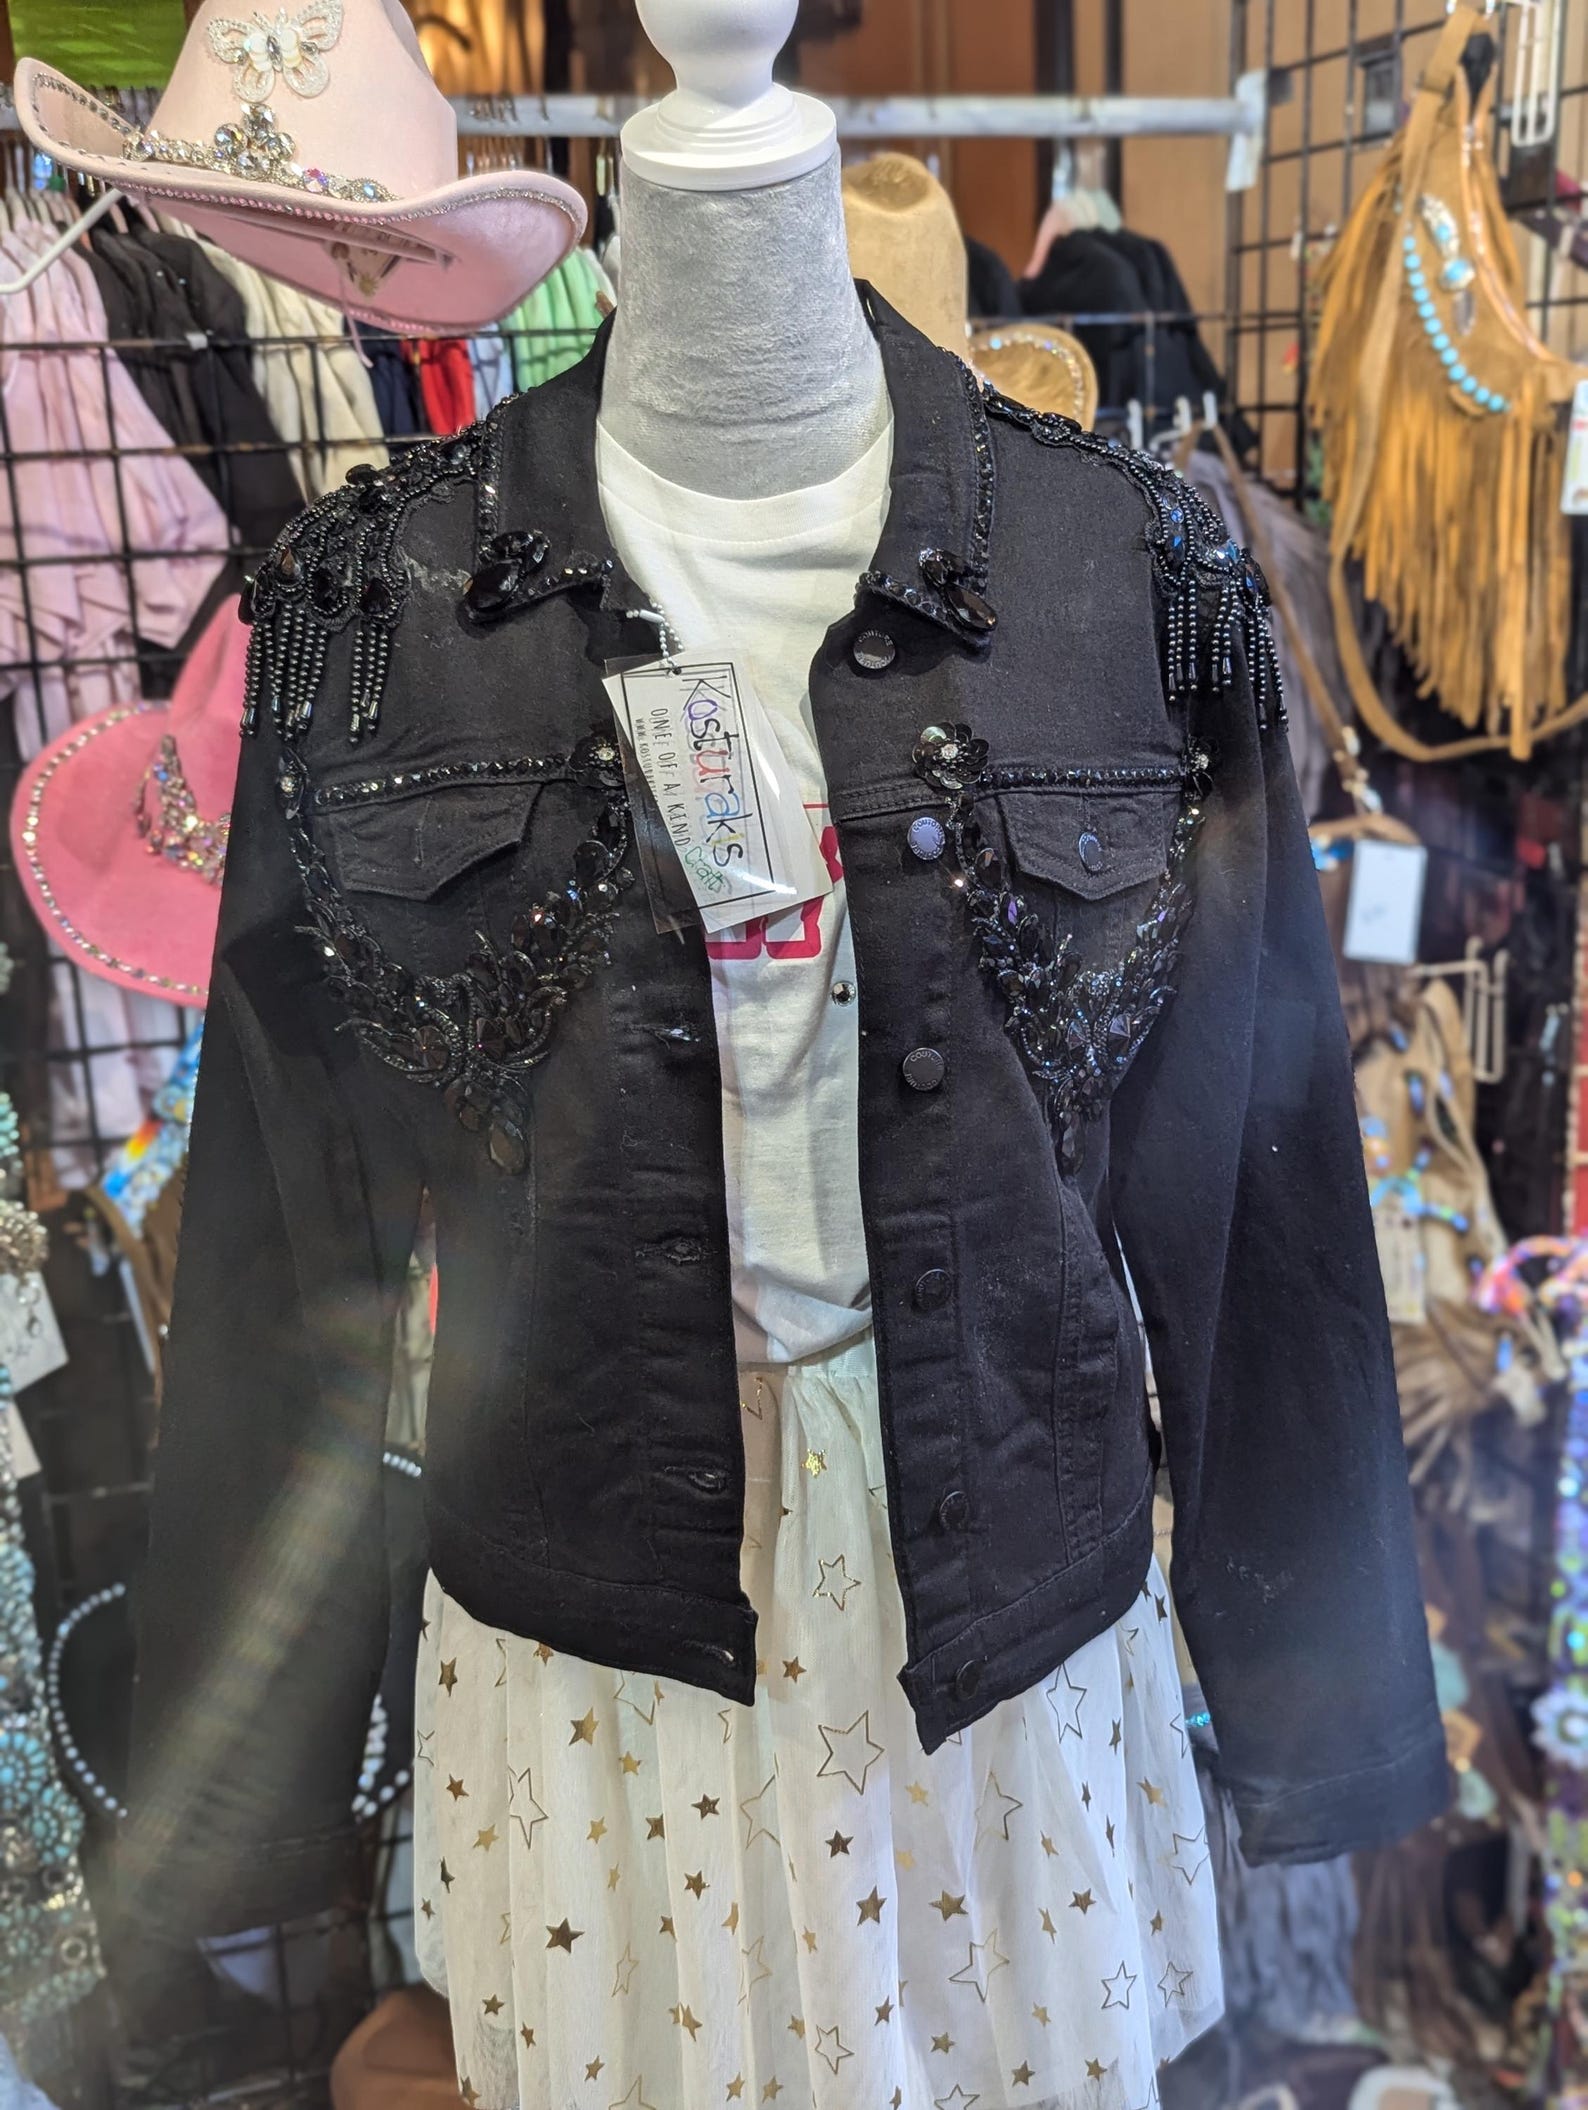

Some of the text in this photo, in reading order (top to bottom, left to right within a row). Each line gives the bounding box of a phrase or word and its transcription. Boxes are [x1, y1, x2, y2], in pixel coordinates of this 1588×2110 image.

[650, 708, 691, 846] ONE OF A KIND
